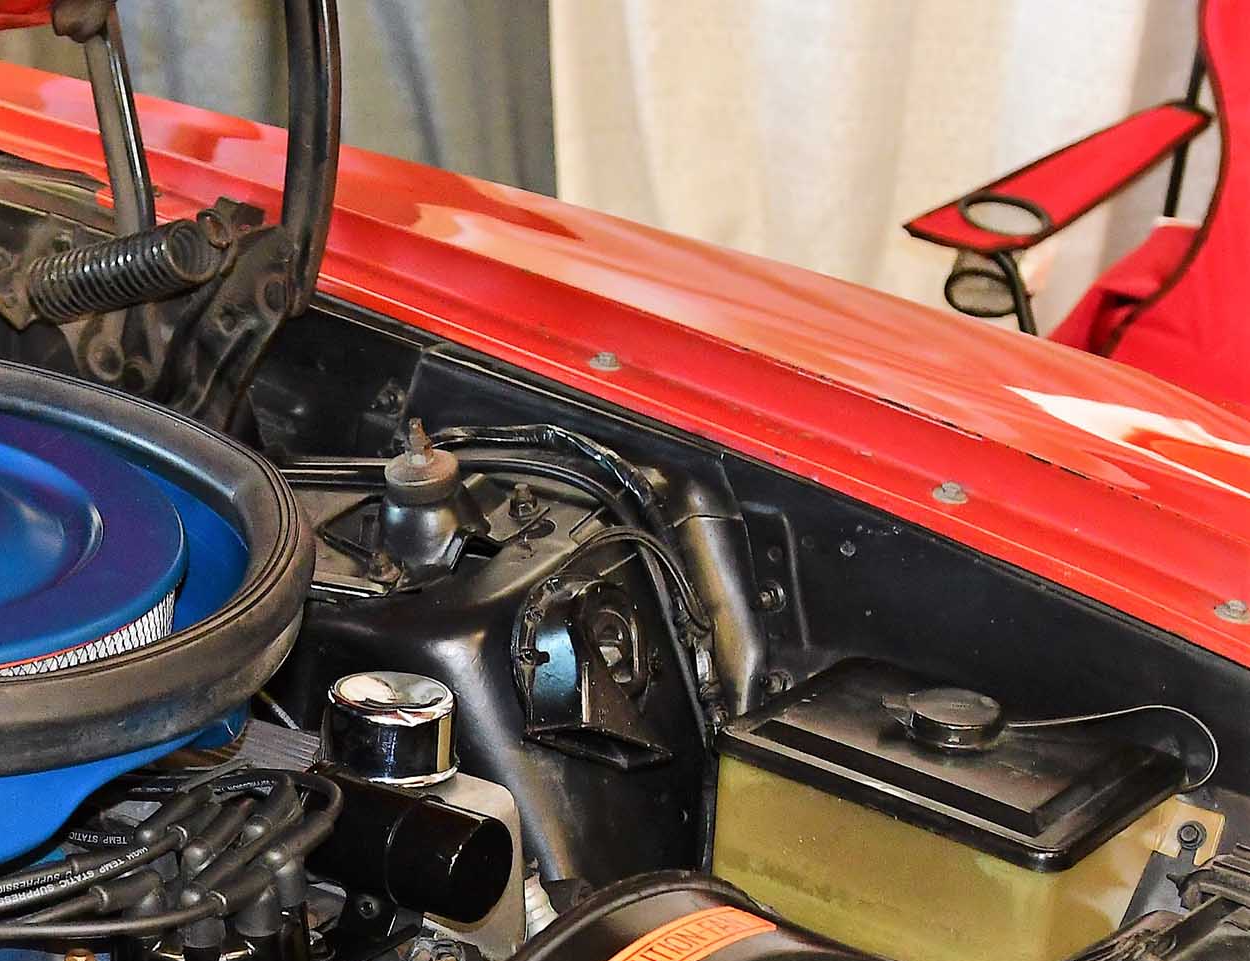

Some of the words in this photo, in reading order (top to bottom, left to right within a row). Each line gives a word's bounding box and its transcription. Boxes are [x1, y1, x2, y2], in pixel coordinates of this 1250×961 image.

[69, 831, 99, 844] STATIC
[103, 835, 128, 845] TEMP
[125, 846, 149, 861] HIGH
[99, 858, 125, 874] TEMP
[59, 870, 95, 889] STATIC
